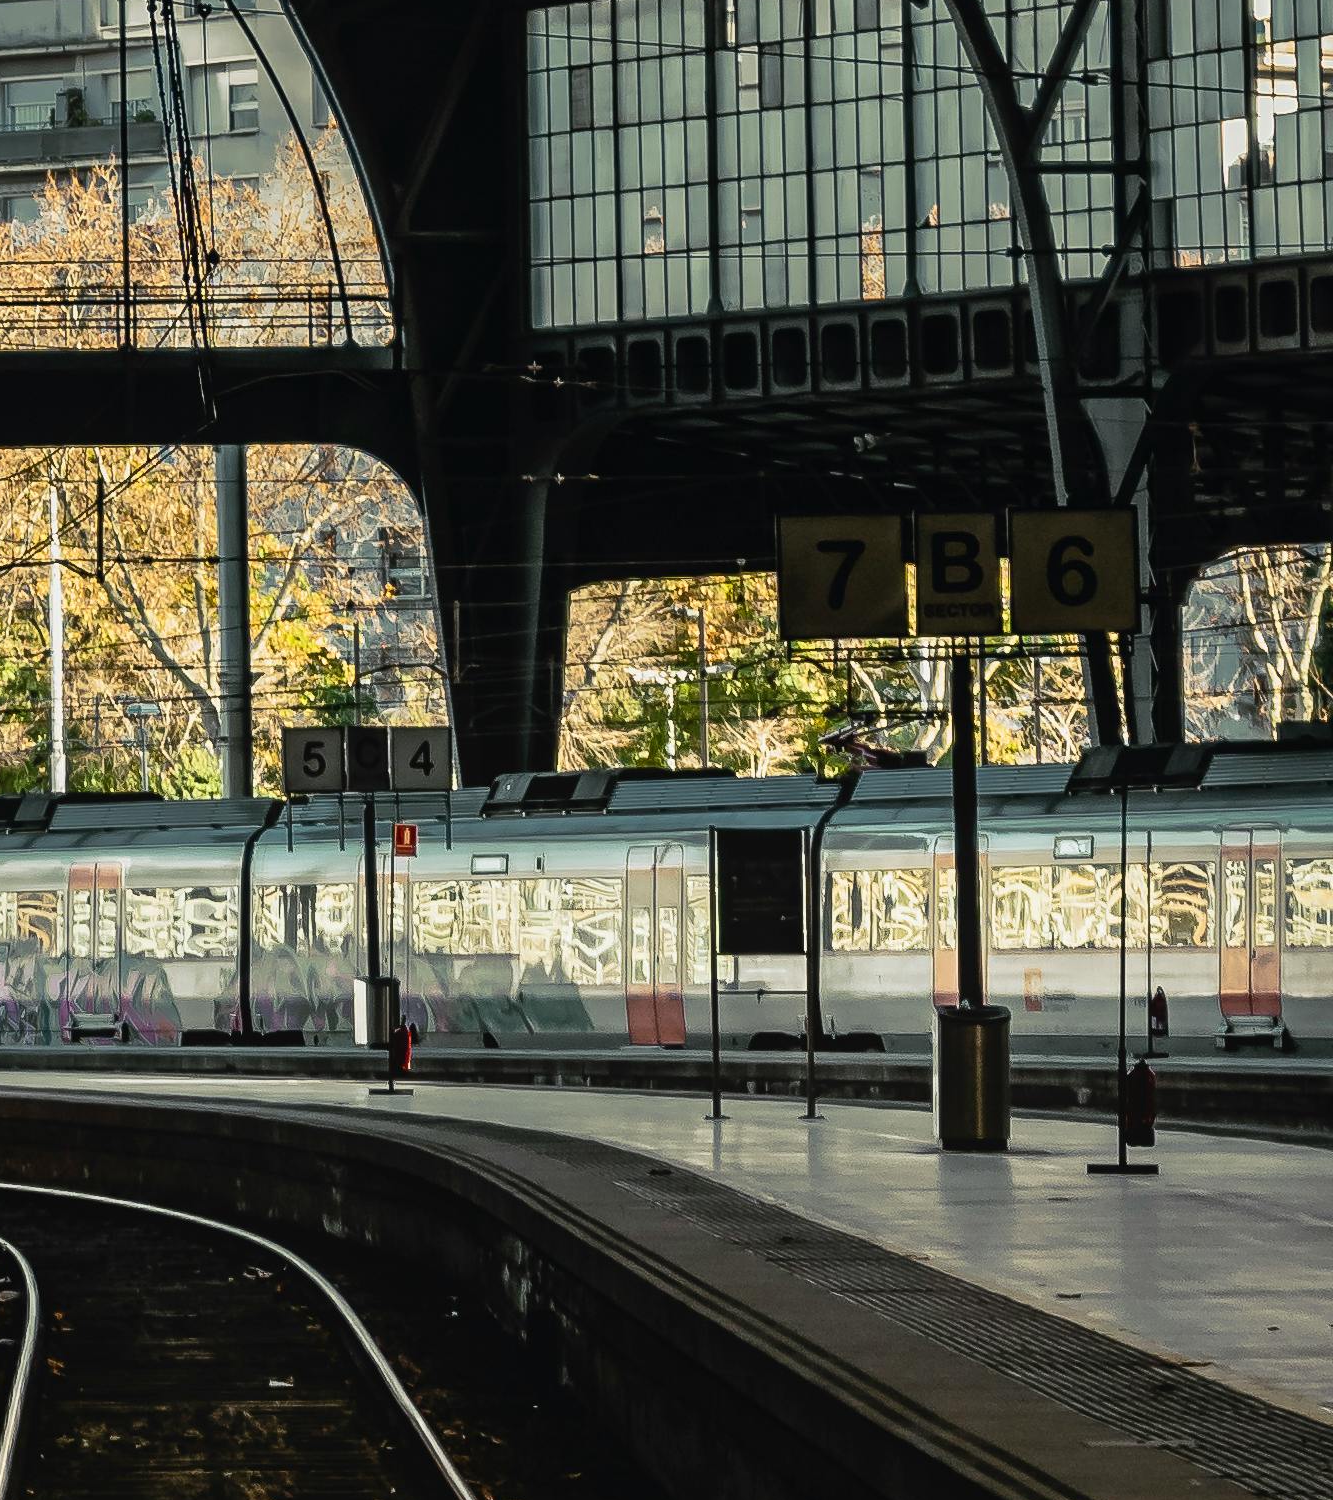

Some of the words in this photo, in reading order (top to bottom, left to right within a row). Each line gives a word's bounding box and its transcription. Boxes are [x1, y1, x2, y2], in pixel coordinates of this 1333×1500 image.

[816, 540, 866, 611] 7
[931, 531, 984, 594] B
[1046, 535, 1099, 606] 6
[923, 602, 995, 618] SECTOR
[303, 741, 327, 778] 5
[409, 740, 434, 777] 4
